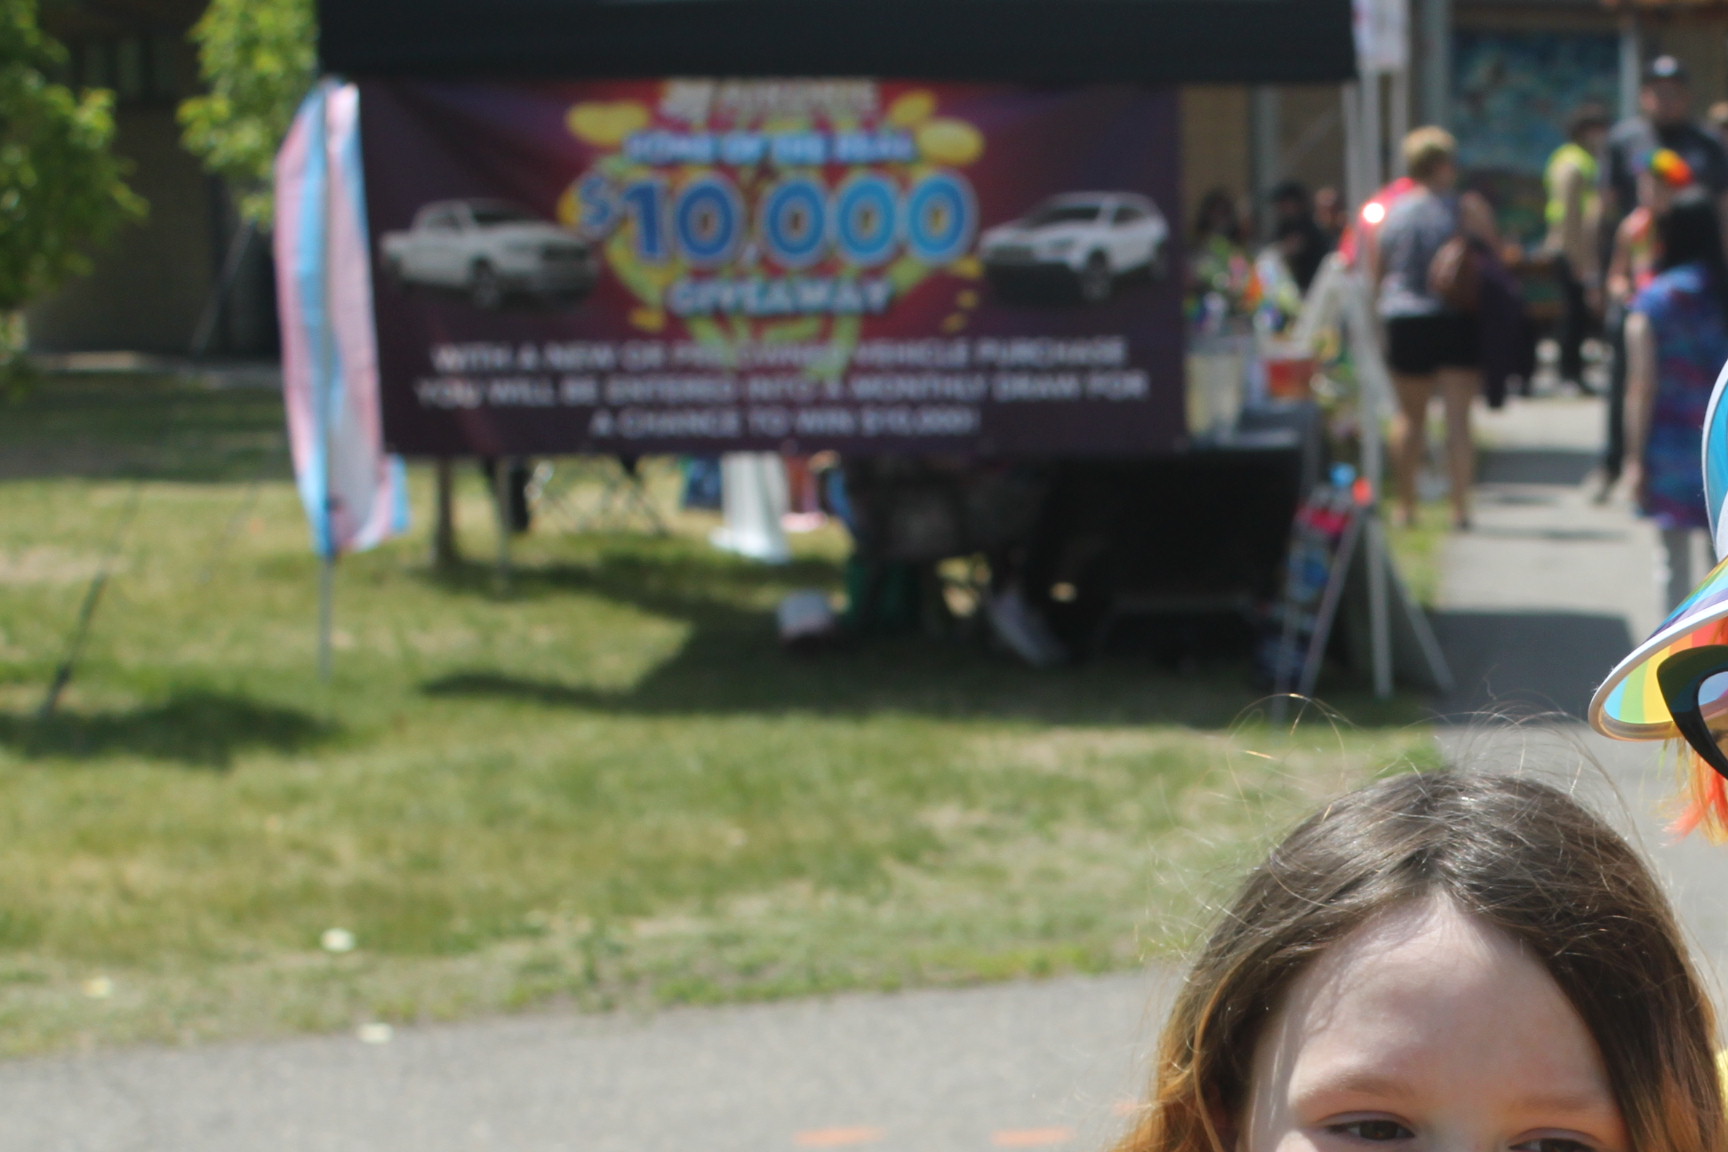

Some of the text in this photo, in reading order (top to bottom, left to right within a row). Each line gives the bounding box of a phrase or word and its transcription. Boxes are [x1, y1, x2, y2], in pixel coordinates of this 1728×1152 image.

[575, 172, 971, 265] $10,000
[666, 279, 893, 316] GIVEAWAY
[431, 343, 511, 371] WITH
[516, 344, 541, 371] A
[545, 343, 616, 371] NEW
[621, 342, 666, 370] OR
[853, 340, 972, 367] VEHICLE
[977, 338, 1127, 365] PURCHASE
[416, 378, 481, 406] YOU
[486, 377, 556, 405] WILL
[561, 377, 600, 404] BE
[606, 377, 738, 403] ENTERED
[743, 376, 815, 402] INTO
[851, 374, 988, 401] MONTHLY
[994, 373, 1081, 399] DRAW
[1088, 371, 1148, 398] FOR
[591, 410, 615, 436] A
[619, 409, 741, 436] CHANCE
[747, 409, 789, 436] TO
[795, 408, 856, 434] WIN
